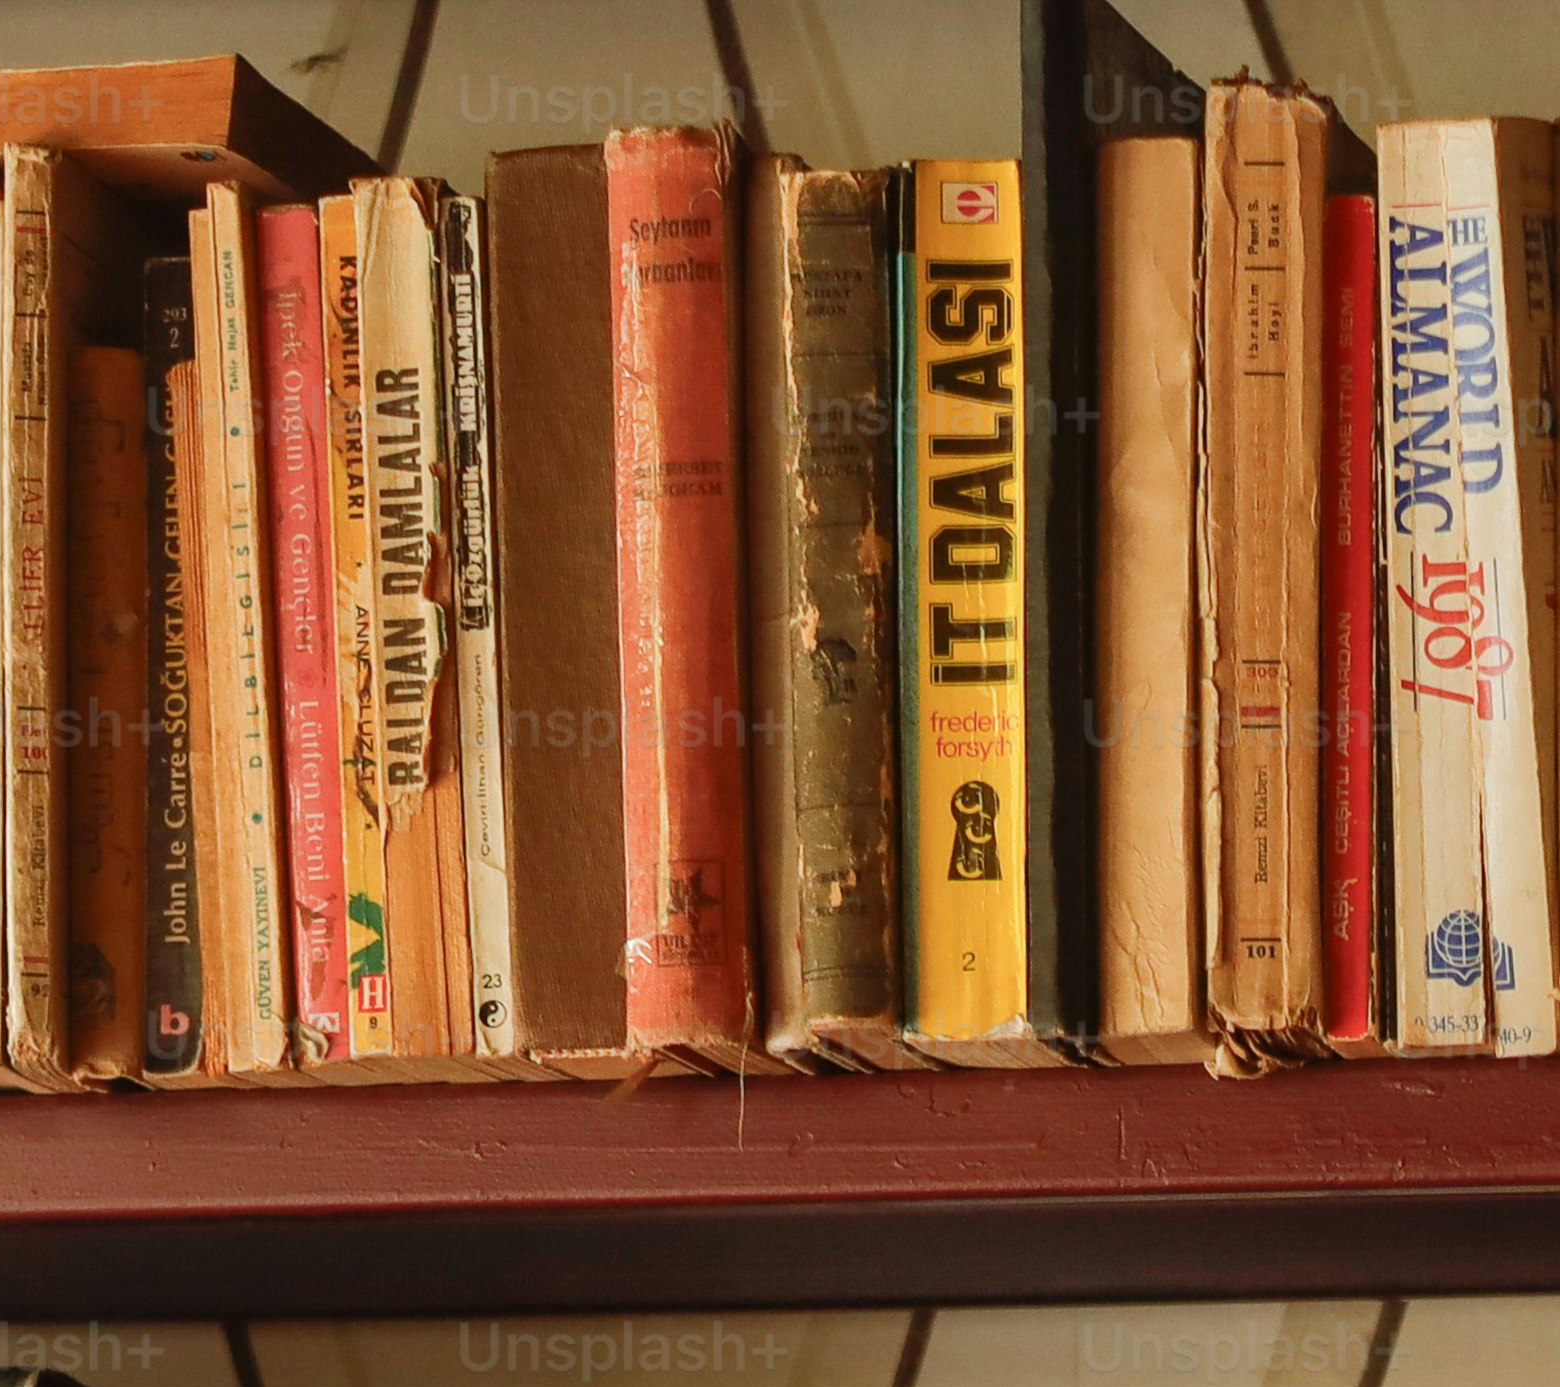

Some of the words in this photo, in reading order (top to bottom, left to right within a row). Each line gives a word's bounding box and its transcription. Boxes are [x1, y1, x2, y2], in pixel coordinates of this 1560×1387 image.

[926, 259, 1016, 588] DALASI
[1388, 216, 1452, 536] ALMANAC
[1444, 248, 1502, 494] WORLD
[379, 365, 422, 595] DAMLALAR
[931, 605, 1017, 687] İT
[1397, 555, 1514, 720] 1987
[483, 973, 502, 988] 23
[961, 950, 976, 972] 2
[1245, 944, 1276, 959] 101
